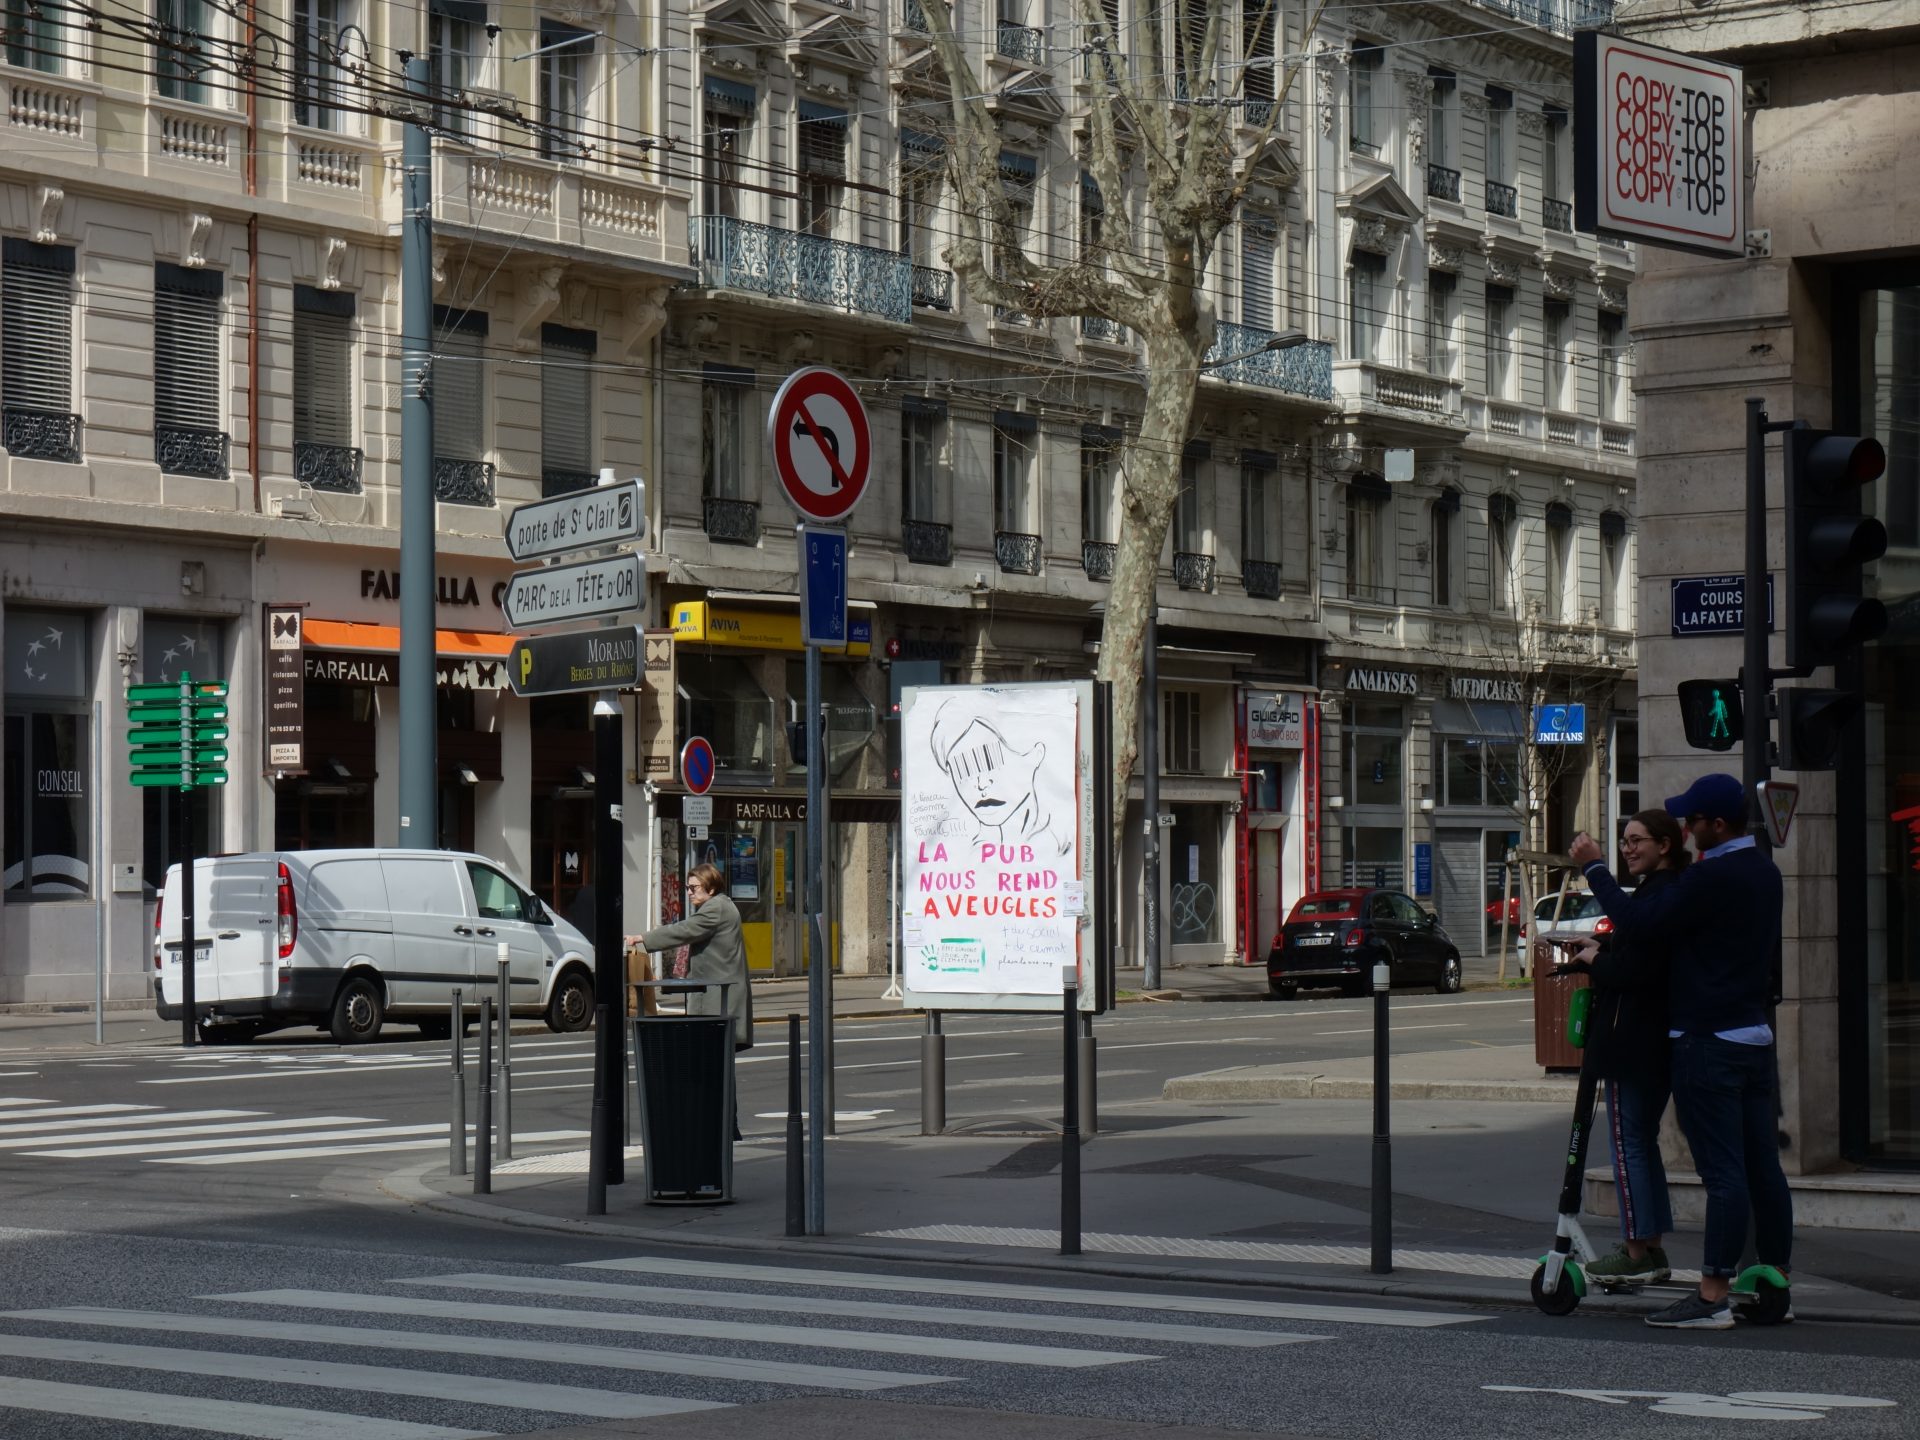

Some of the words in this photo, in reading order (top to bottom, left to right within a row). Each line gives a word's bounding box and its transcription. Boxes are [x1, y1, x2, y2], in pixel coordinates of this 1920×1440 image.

[1616, 72, 1725, 125] COPY-TOP
[518, 522, 548, 553] porte
[553, 512, 566, 540] de
[571, 508, 581, 535] St
[586, 501, 615, 532] Clair
[361, 570, 480, 606] FALLA
[516, 584, 546, 613] PARC
[550, 590, 560, 608] DE
[561, 588, 571, 606] LA
[577, 570, 604, 603] TÊTE
[1700, 591, 1743, 606] COURS
[710, 618, 741, 632] AVIVA
[1682, 609, 1744, 625] LAFAYET
[304, 659, 390, 682] FARFALLA
[520, 648, 532, 686] P
[588, 639, 635, 663] MORAND
[570, 666, 593, 682] BERGES
[597, 669, 607, 679] DU
[611, 662, 634, 678] RHÔNE
[278, 686, 293, 694] pizza
[1347, 669, 1416, 694] ANALYSES
[273, 701, 298, 710] aperitivo
[1251, 710, 1299, 723] GUIGARD
[38, 769, 83, 792] CONSEIL
[736, 803, 791, 819] FARFALLA
[1161, 816, 1172, 825] 54
[918, 841, 949, 864] LA
[981, 843, 1035, 864] PUB
[920, 870, 976, 892] NOUS
[998, 870, 1058, 892] REND
[924, 894, 1057, 919] AVEUGLES
